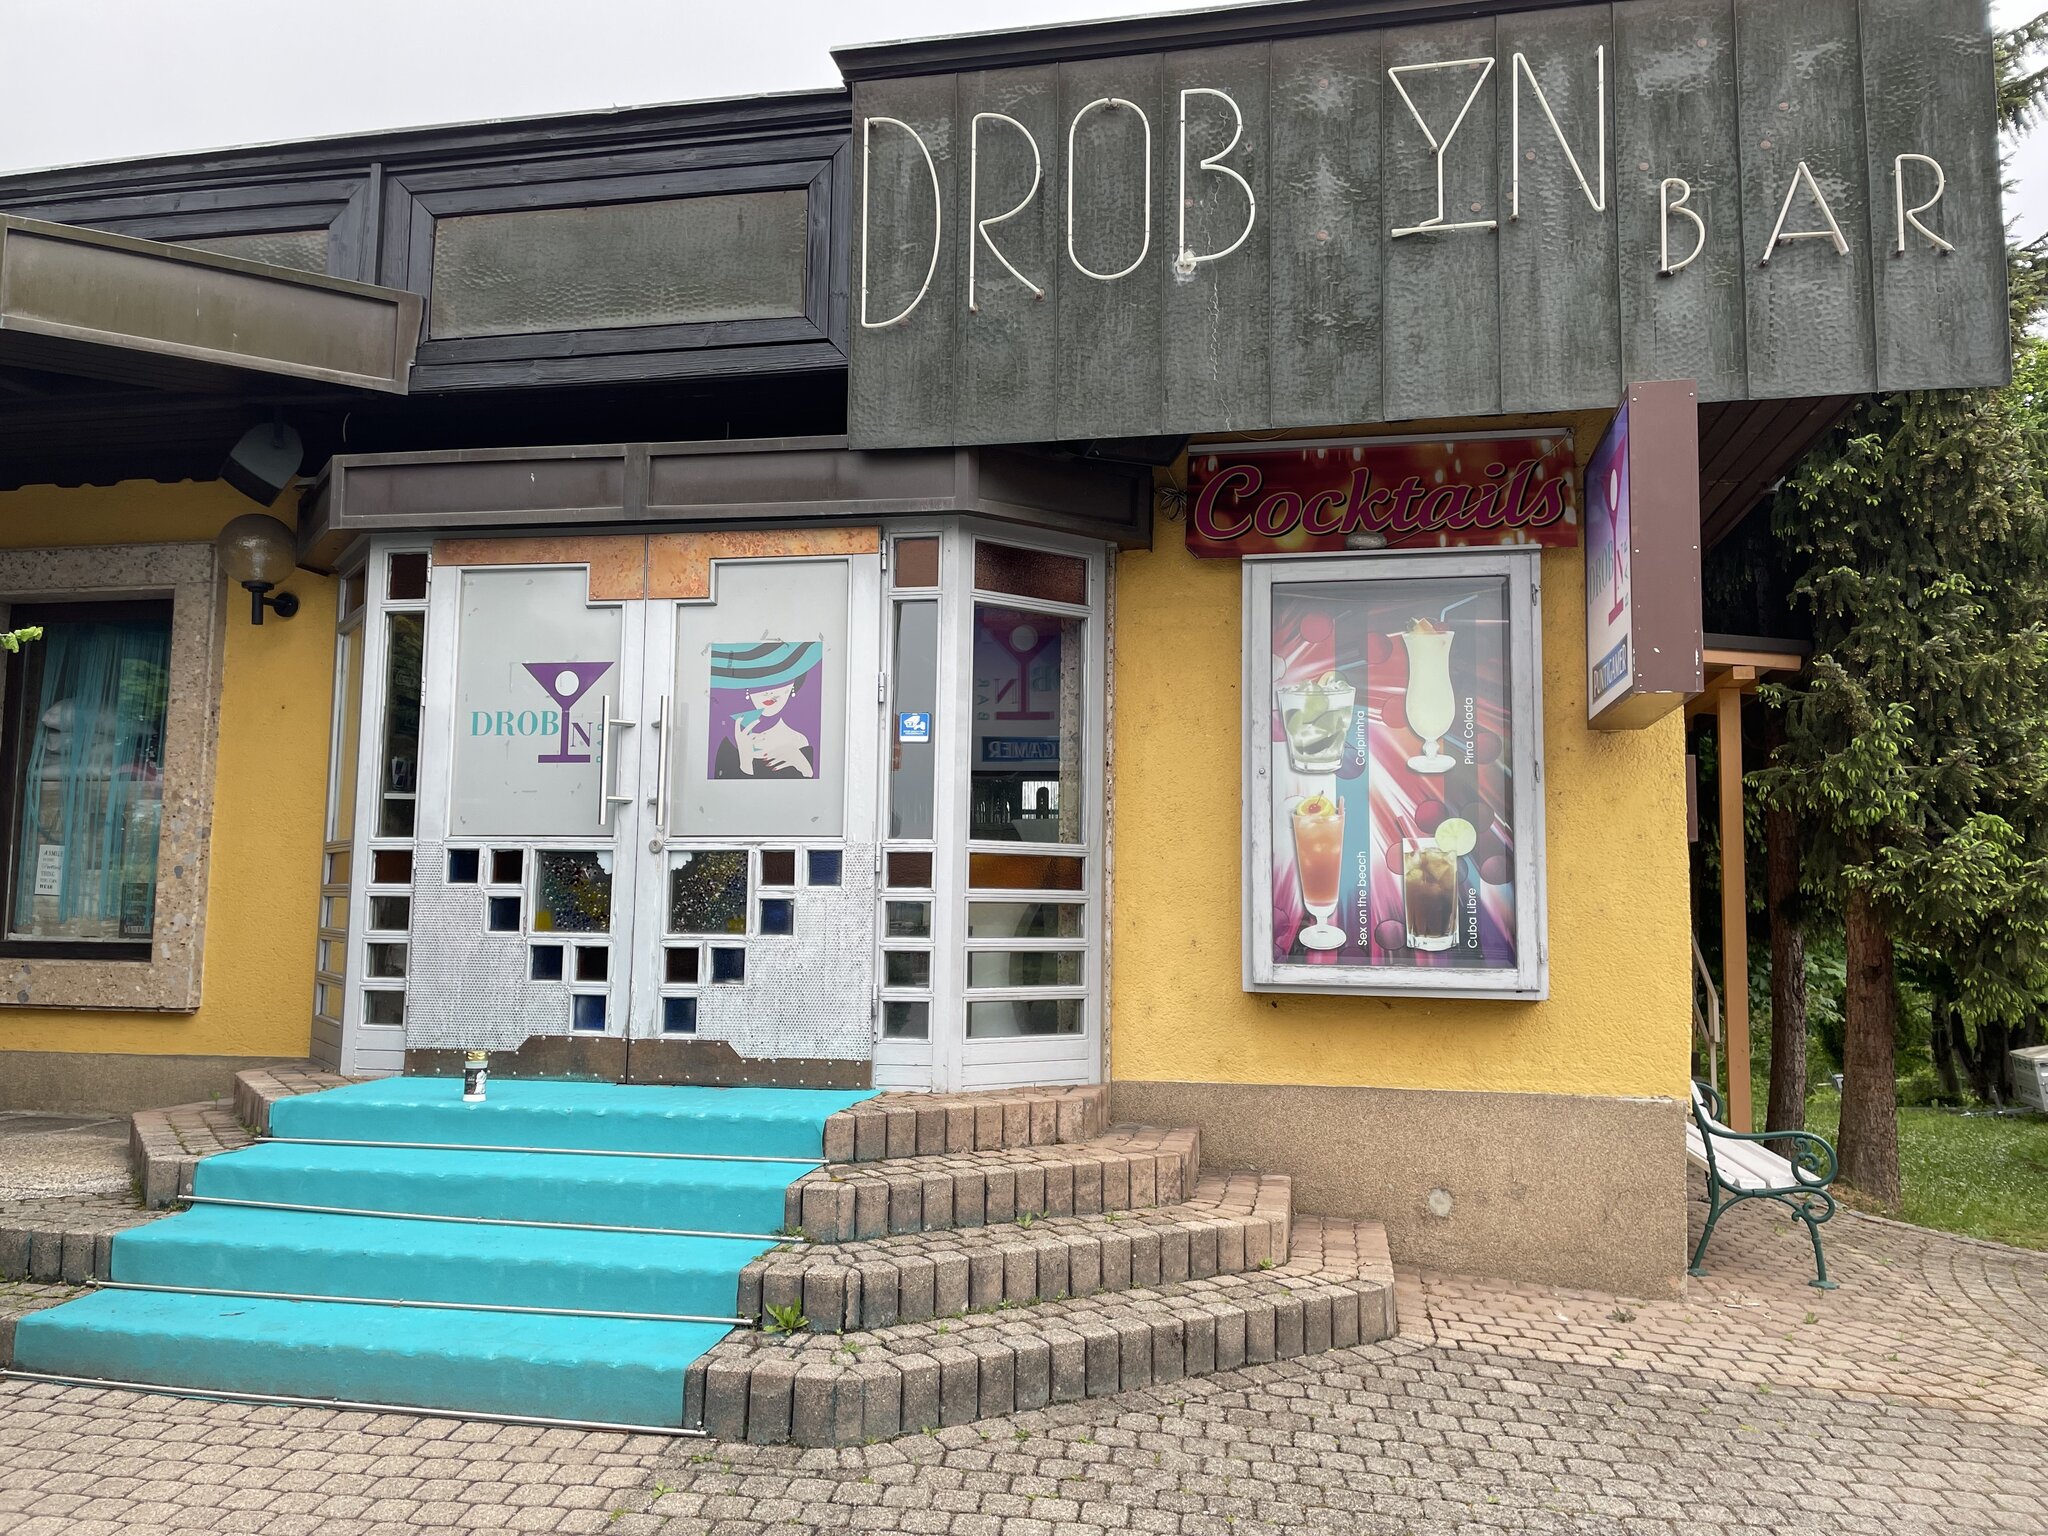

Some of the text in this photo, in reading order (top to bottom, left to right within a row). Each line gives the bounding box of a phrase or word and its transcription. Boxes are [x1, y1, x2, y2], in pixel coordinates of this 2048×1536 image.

[1659, 153, 1955, 275] BAR
[1195, 459, 1566, 541] Cocktails
[1355, 710, 1367, 766] Caipirinha
[1463, 697, 1474, 739] Colada
[1356, 851, 1368, 946] Sex on the beach
[1466, 888, 1478, 949] Cuba Libre
